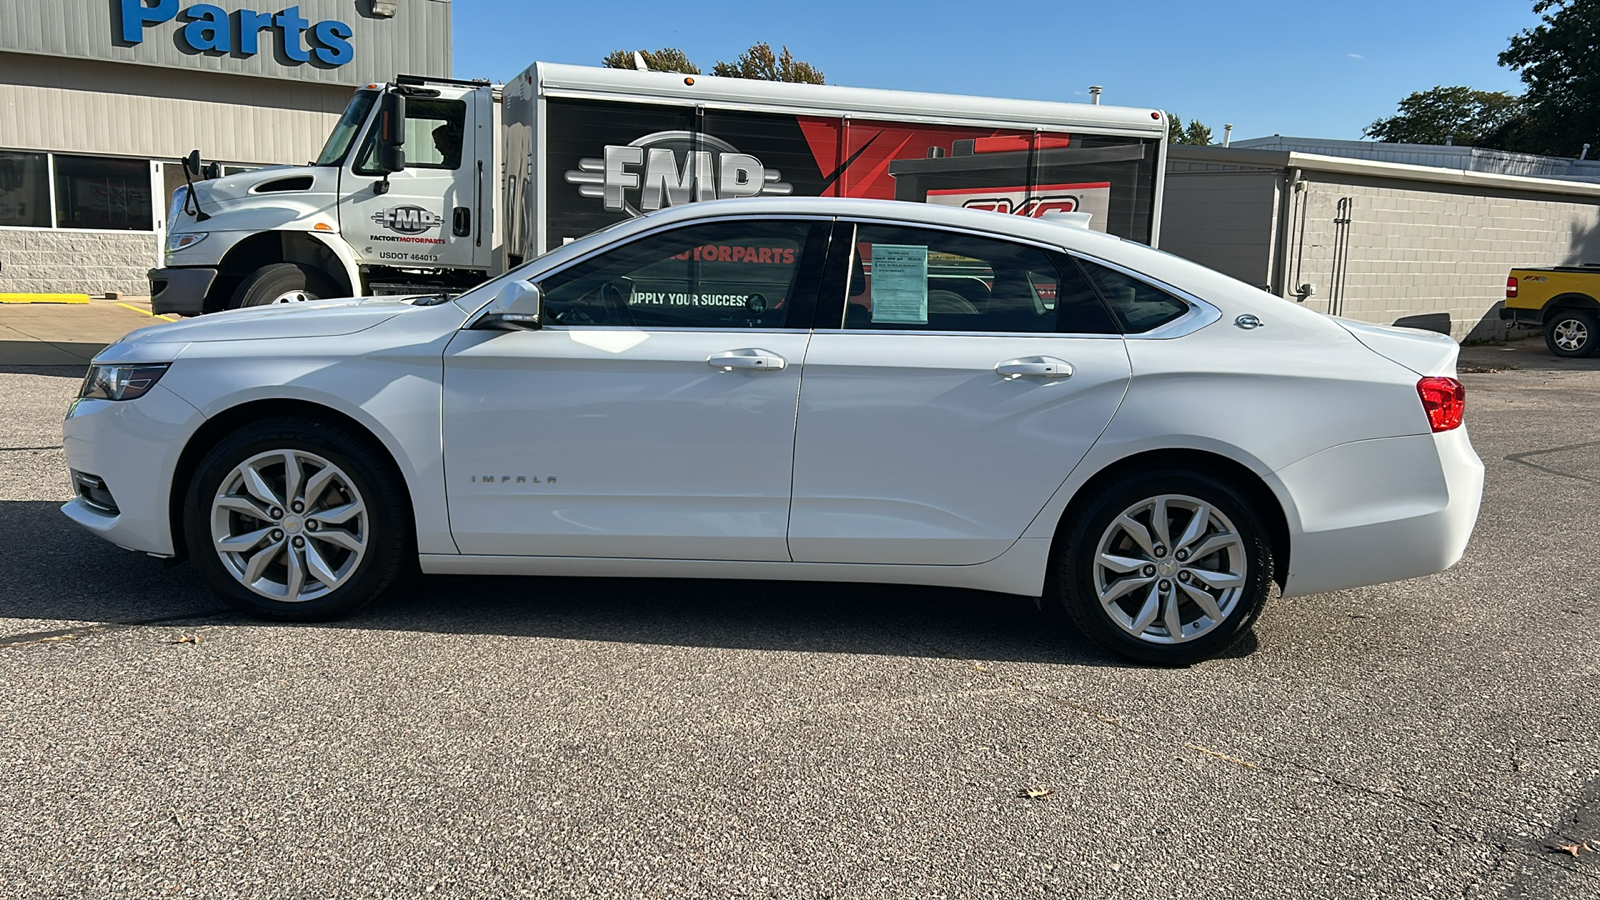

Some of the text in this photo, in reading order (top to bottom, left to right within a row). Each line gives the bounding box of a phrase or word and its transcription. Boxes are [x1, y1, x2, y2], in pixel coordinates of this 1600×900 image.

[121, 0, 354, 65] Parts
[604, 145, 765, 211] FMP
[383, 208, 435, 229] FMP
[380, 252, 438, 262] USDOT 464013
[669, 244, 795, 264] TORPARTS
[633, 292, 749, 307] UPPLY YOUR SUCCESS
[471, 475, 557, 483] IMPALA
